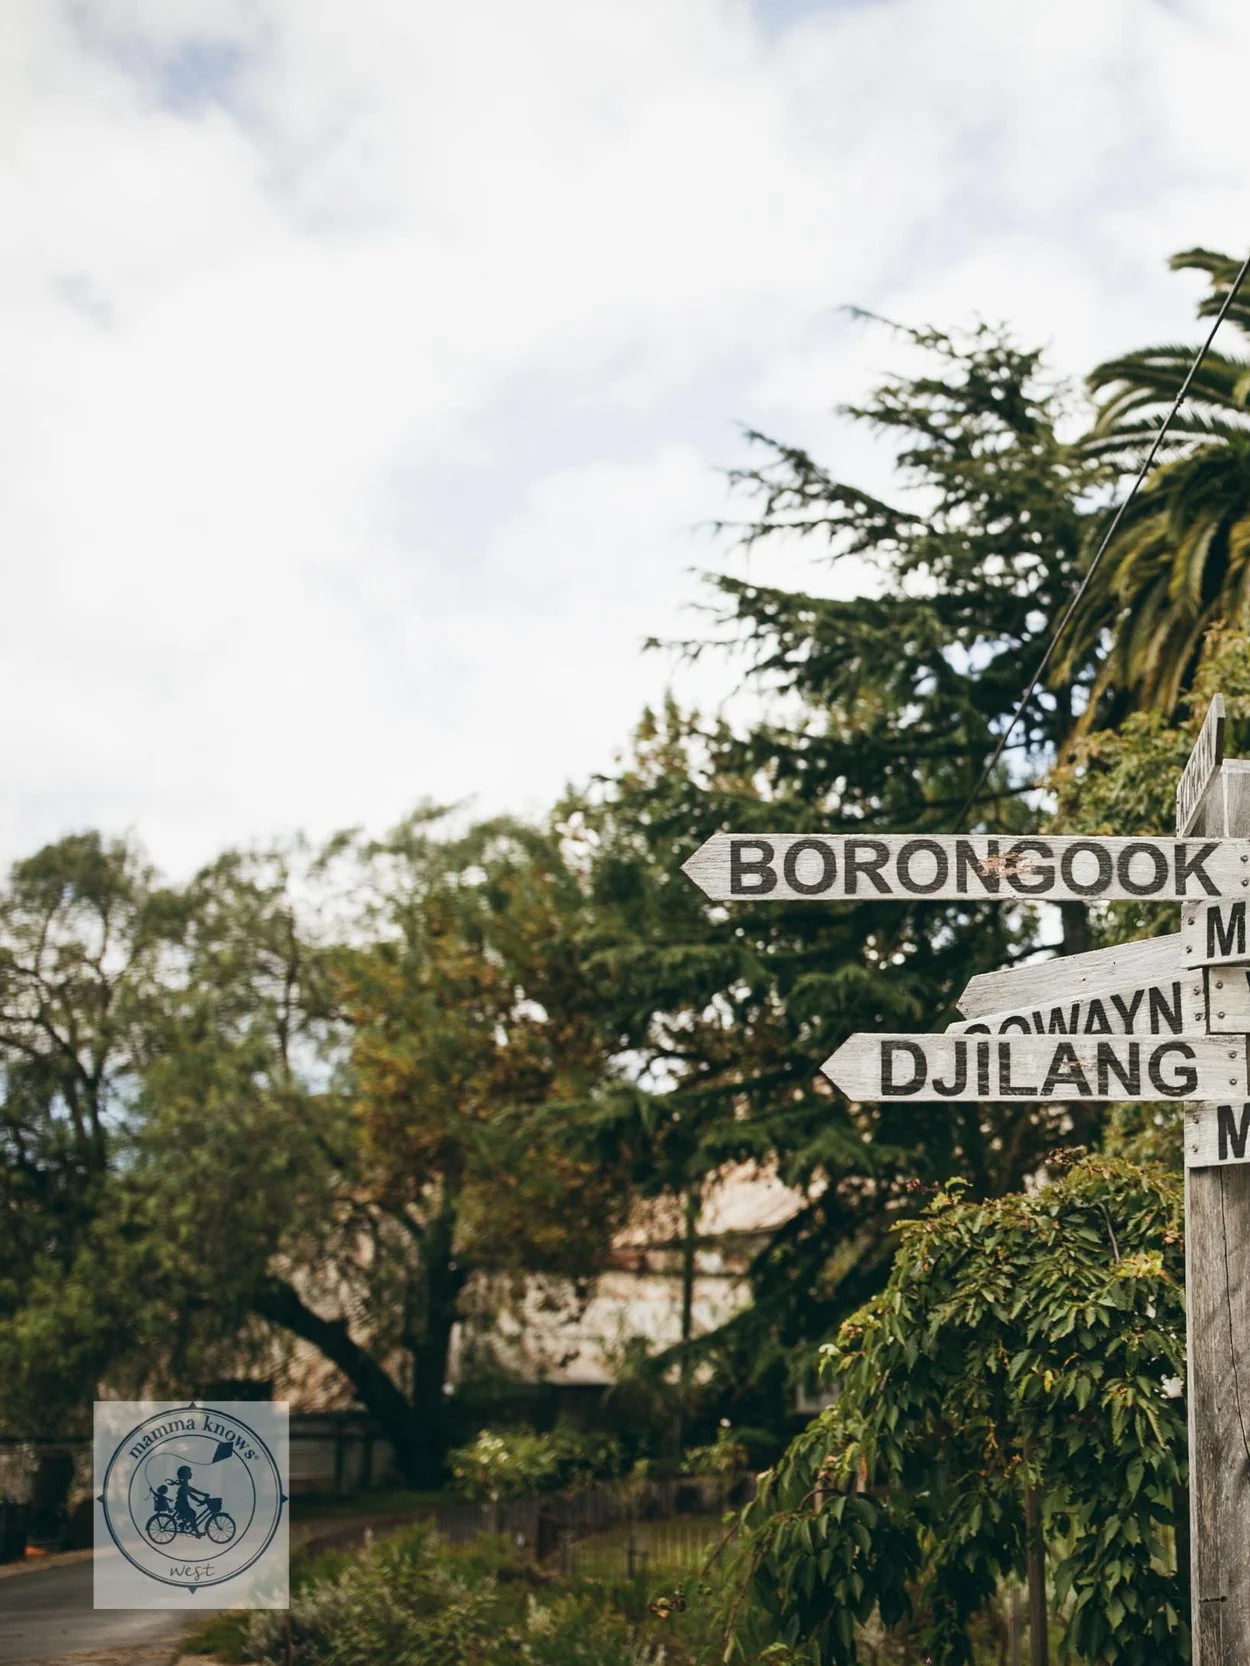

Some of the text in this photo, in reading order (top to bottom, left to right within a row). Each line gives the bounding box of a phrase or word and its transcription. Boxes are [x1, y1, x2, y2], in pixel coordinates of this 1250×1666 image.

[729, 839, 1221, 897] BORONGOOK
[963, 981, 1183, 1035] WAYN
[880, 1040, 1198, 1097] DJILANG
